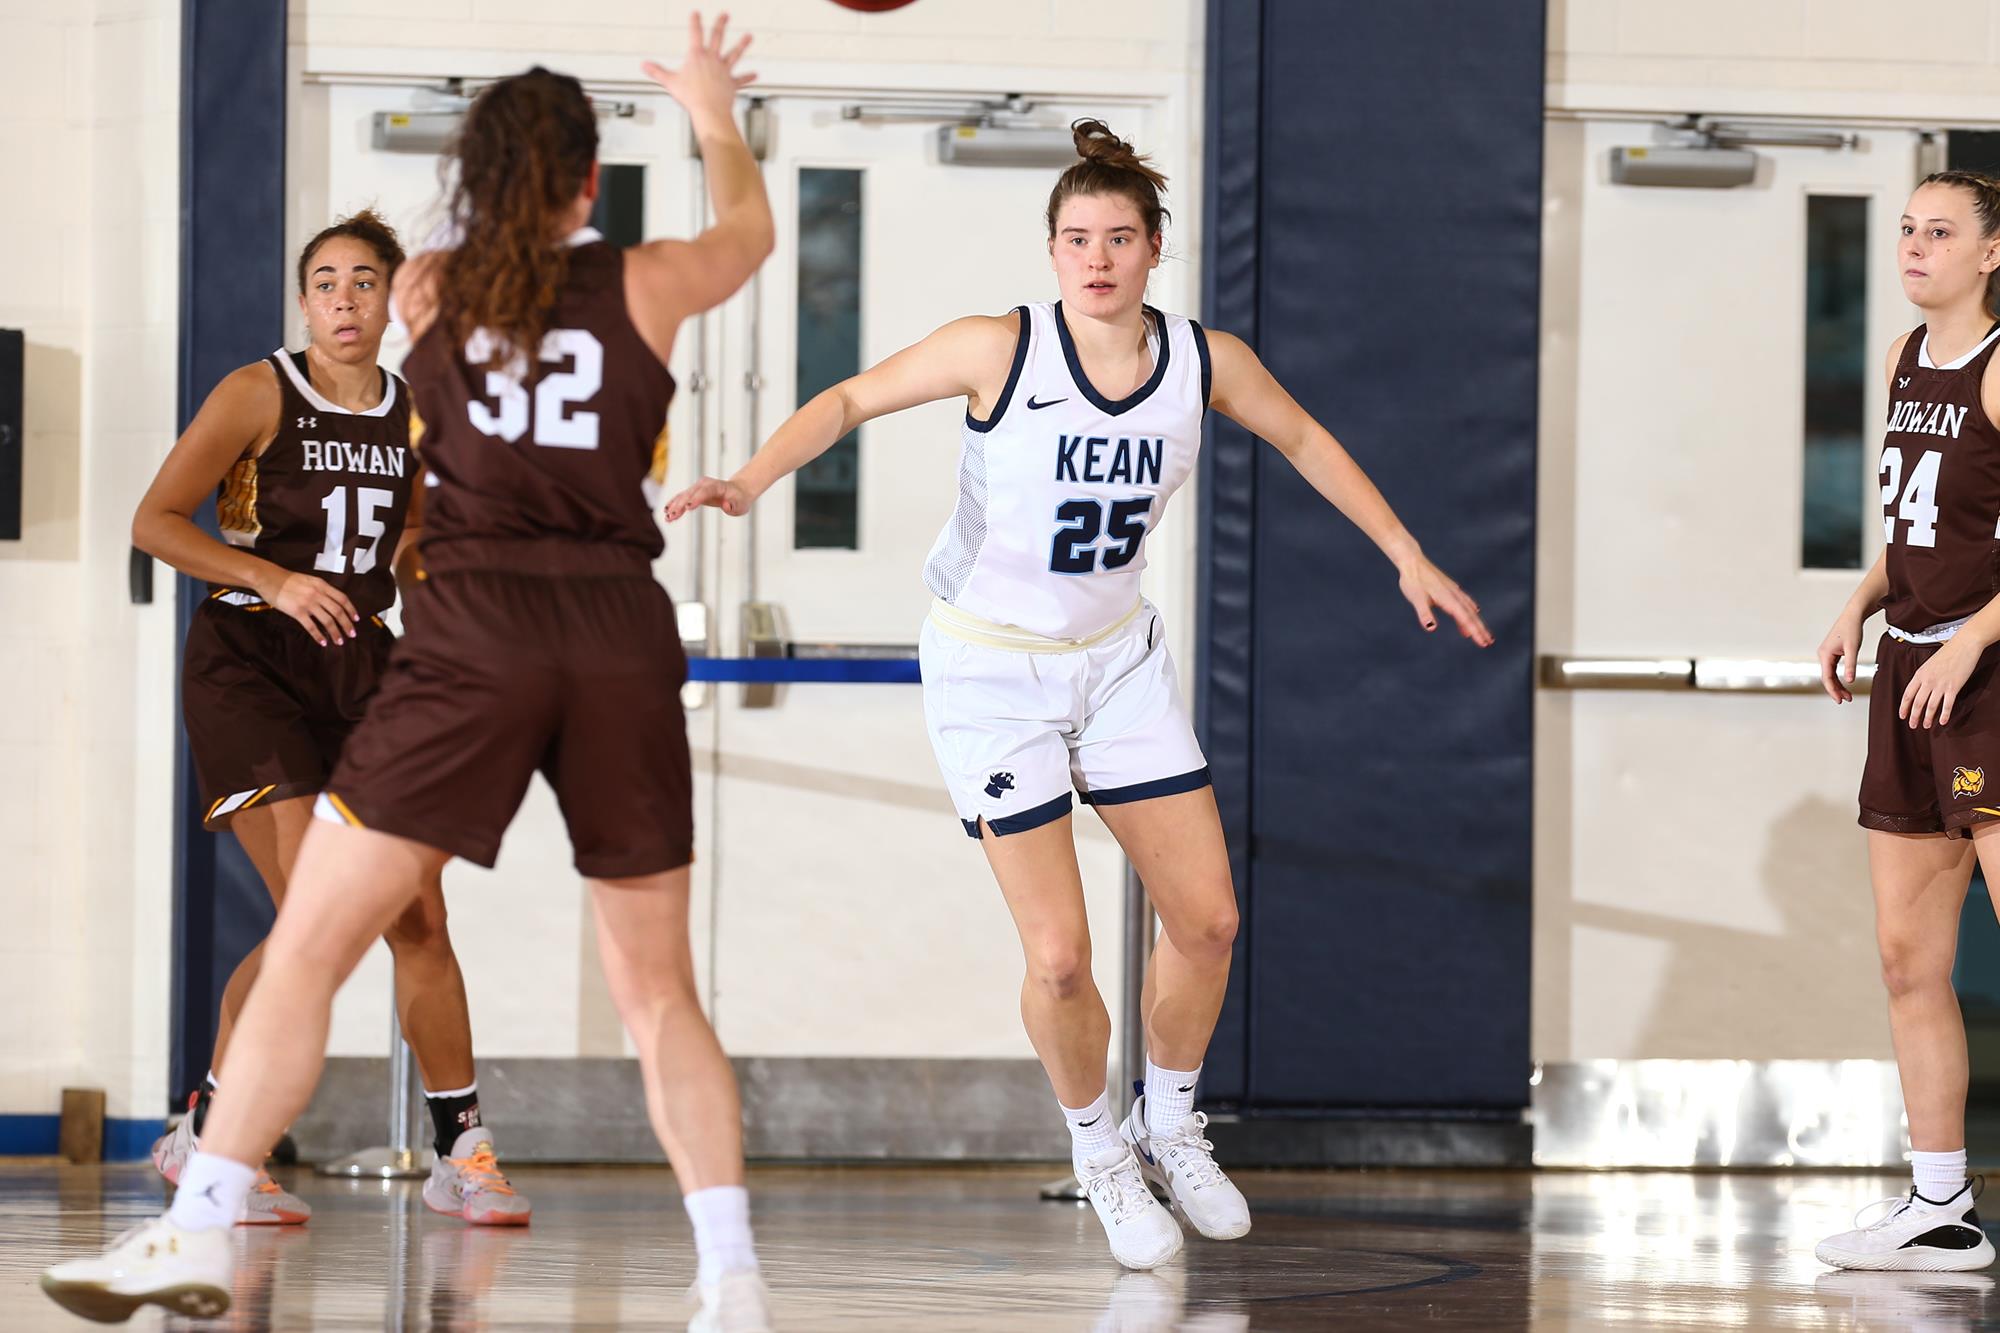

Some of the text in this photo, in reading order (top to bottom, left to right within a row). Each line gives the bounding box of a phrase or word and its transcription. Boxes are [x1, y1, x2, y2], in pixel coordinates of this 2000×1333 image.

[465, 325, 604, 450] 32
[301, 440, 405, 478] ROWAN
[1055, 434, 1165, 485] KEAN
[1879, 446, 1943, 548] 24
[313, 485, 394, 575] 15
[1048, 494, 1157, 576] 25
